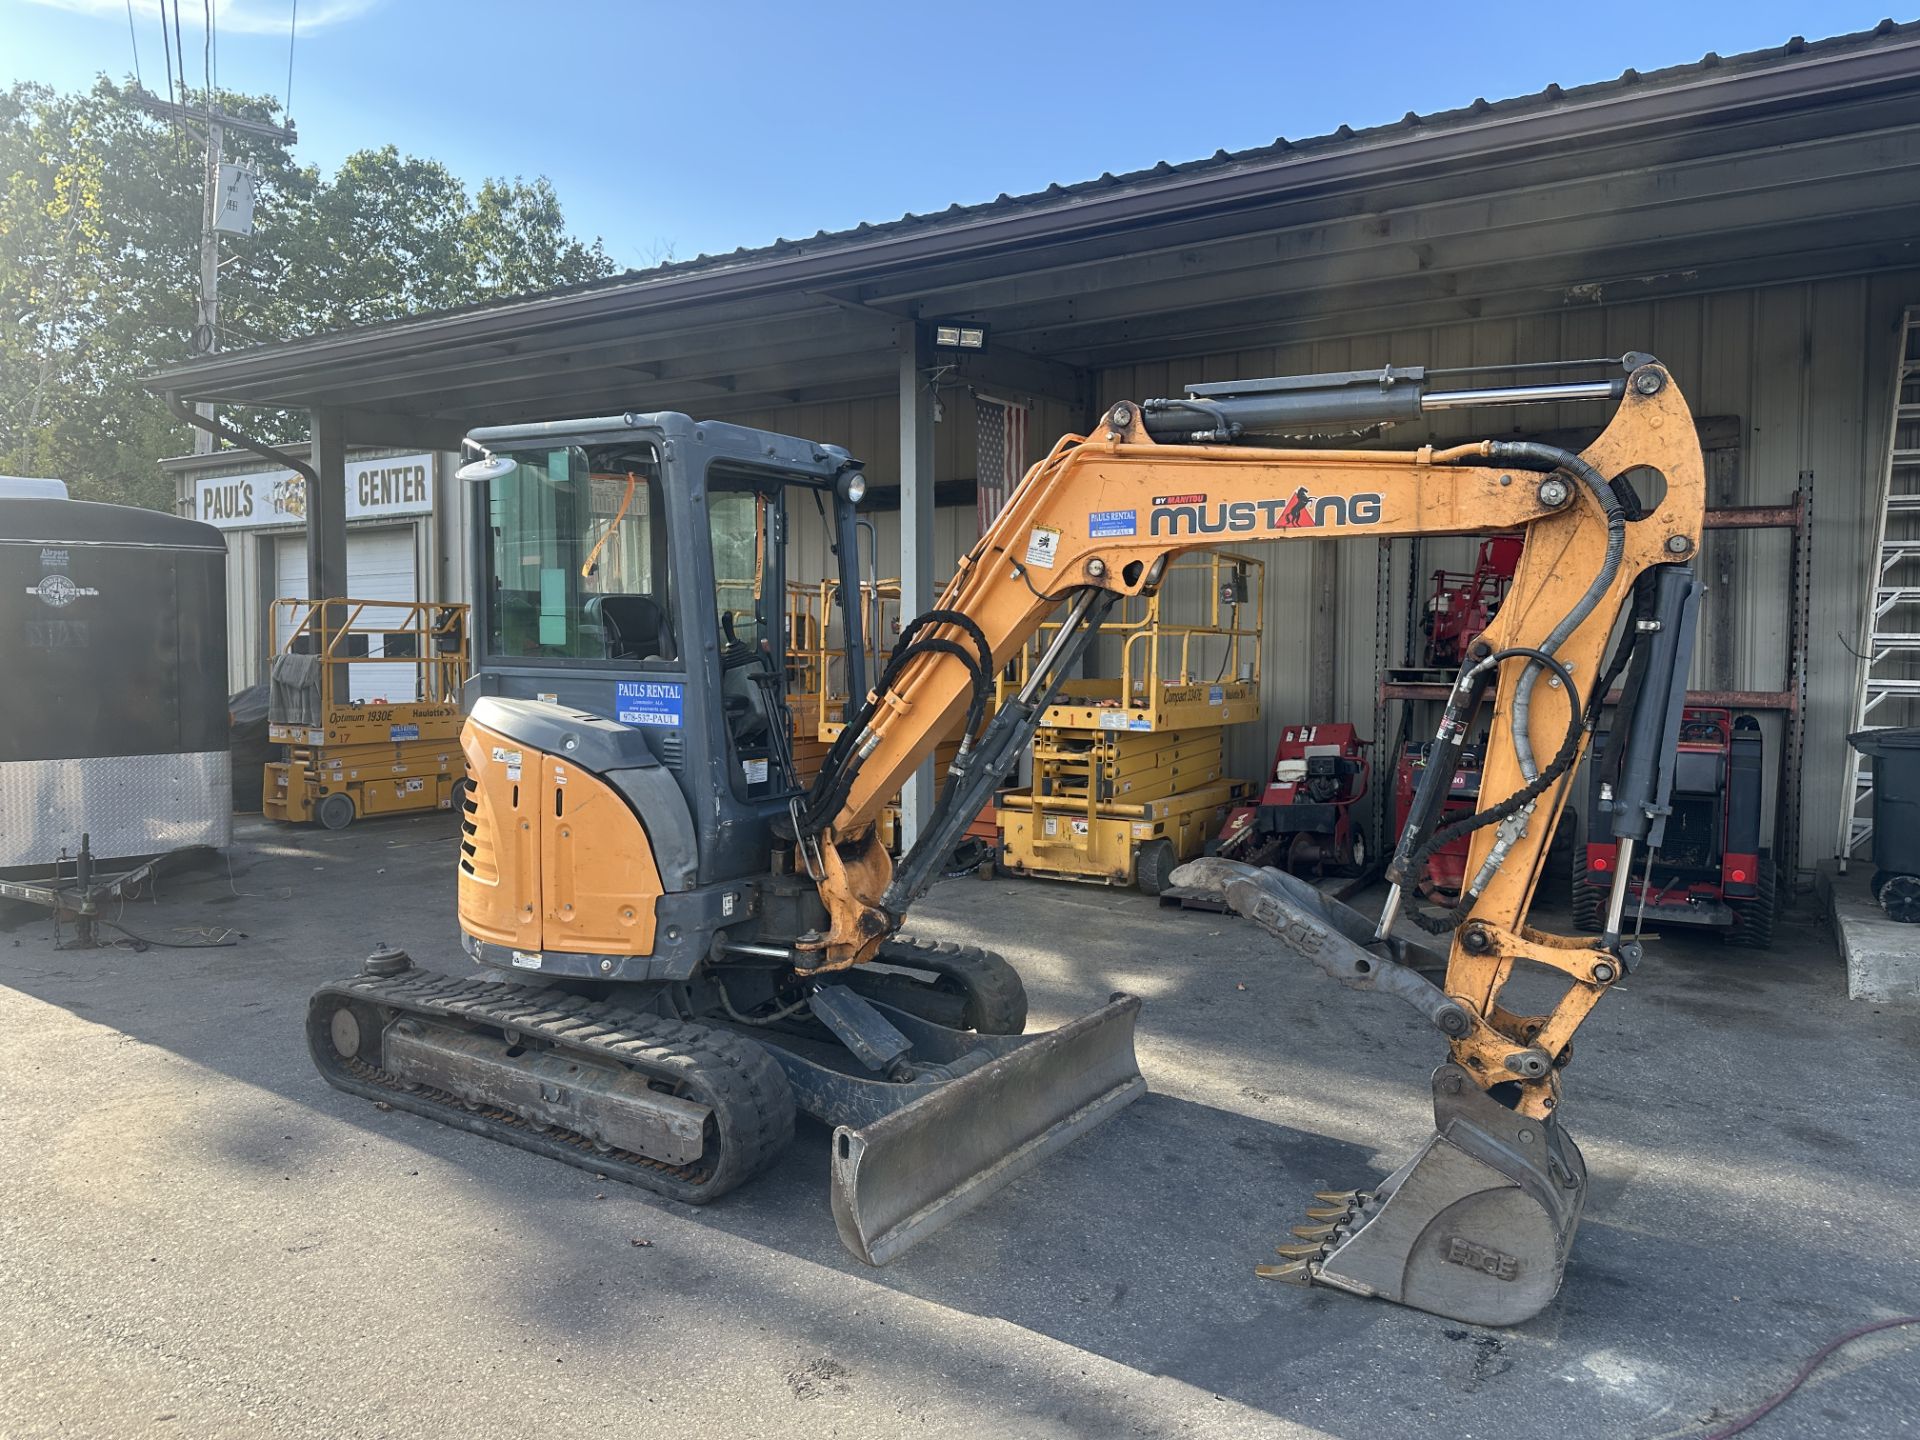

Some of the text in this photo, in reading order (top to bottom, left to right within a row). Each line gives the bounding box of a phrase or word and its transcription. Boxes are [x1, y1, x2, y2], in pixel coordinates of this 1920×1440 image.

[203, 465, 427, 521] PAUL'S CENTER
[1167, 494, 1204, 504] MANITOU
[1111, 511, 1135, 521] RENTAL
[1150, 488, 1381, 536] MUSTANG
[618, 683, 681, 698] PAULS RENTAL
[1163, 688, 1187, 705] Compact
[329, 710, 394, 724] Optimum 1930E
[412, 708, 444, 718] Haulotte
[339, 733, 350, 743] 17
[1255, 895, 1328, 955] EDGE
[1449, 1238, 1517, 1281] EDGE
